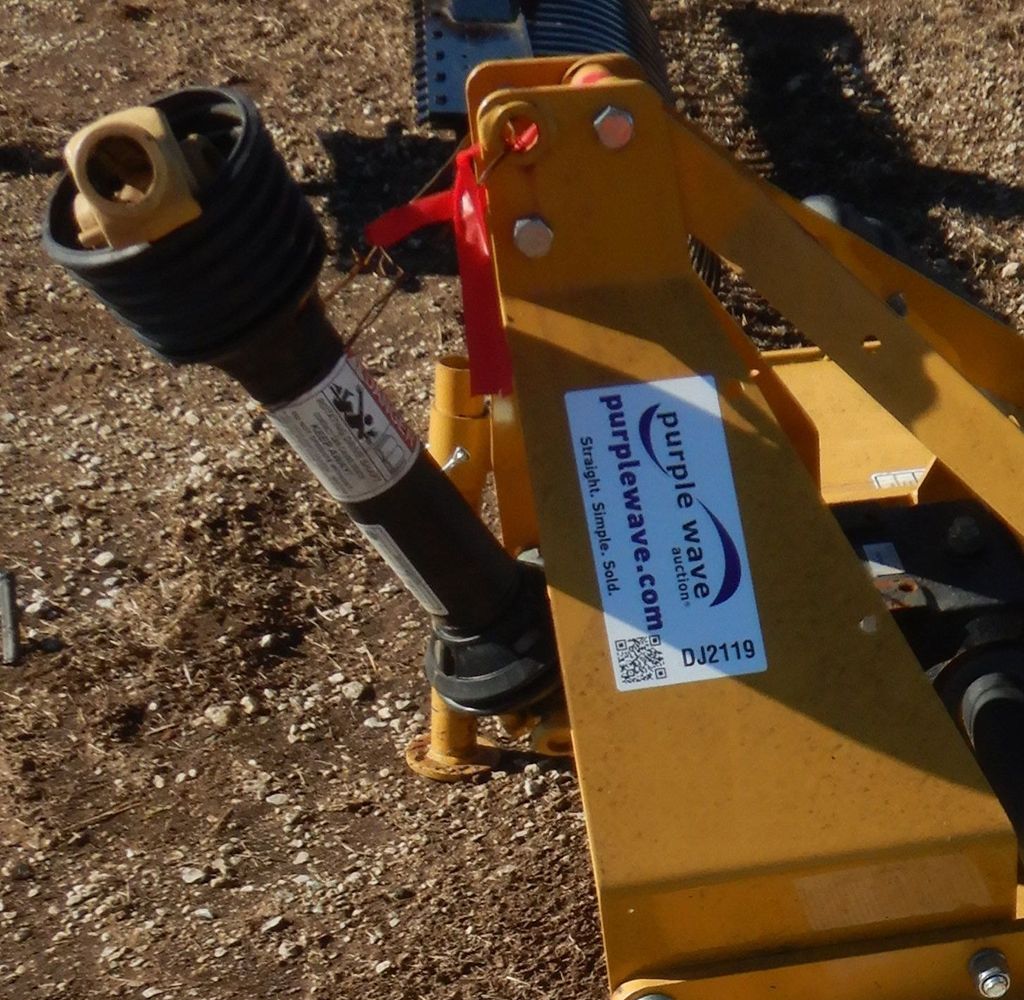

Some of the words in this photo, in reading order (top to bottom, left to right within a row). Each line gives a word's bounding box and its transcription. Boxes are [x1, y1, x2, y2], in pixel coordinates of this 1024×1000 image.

[580, 436, 600, 498] Straight.
[592, 502, 610, 557] Simple.
[603, 560, 620, 596] Sold.
[599, 394, 664, 631] purplewave.com
[657, 410, 697, 509] purple
[682, 518, 711, 600] wave
[682, 639, 757, 667] DJ2119
